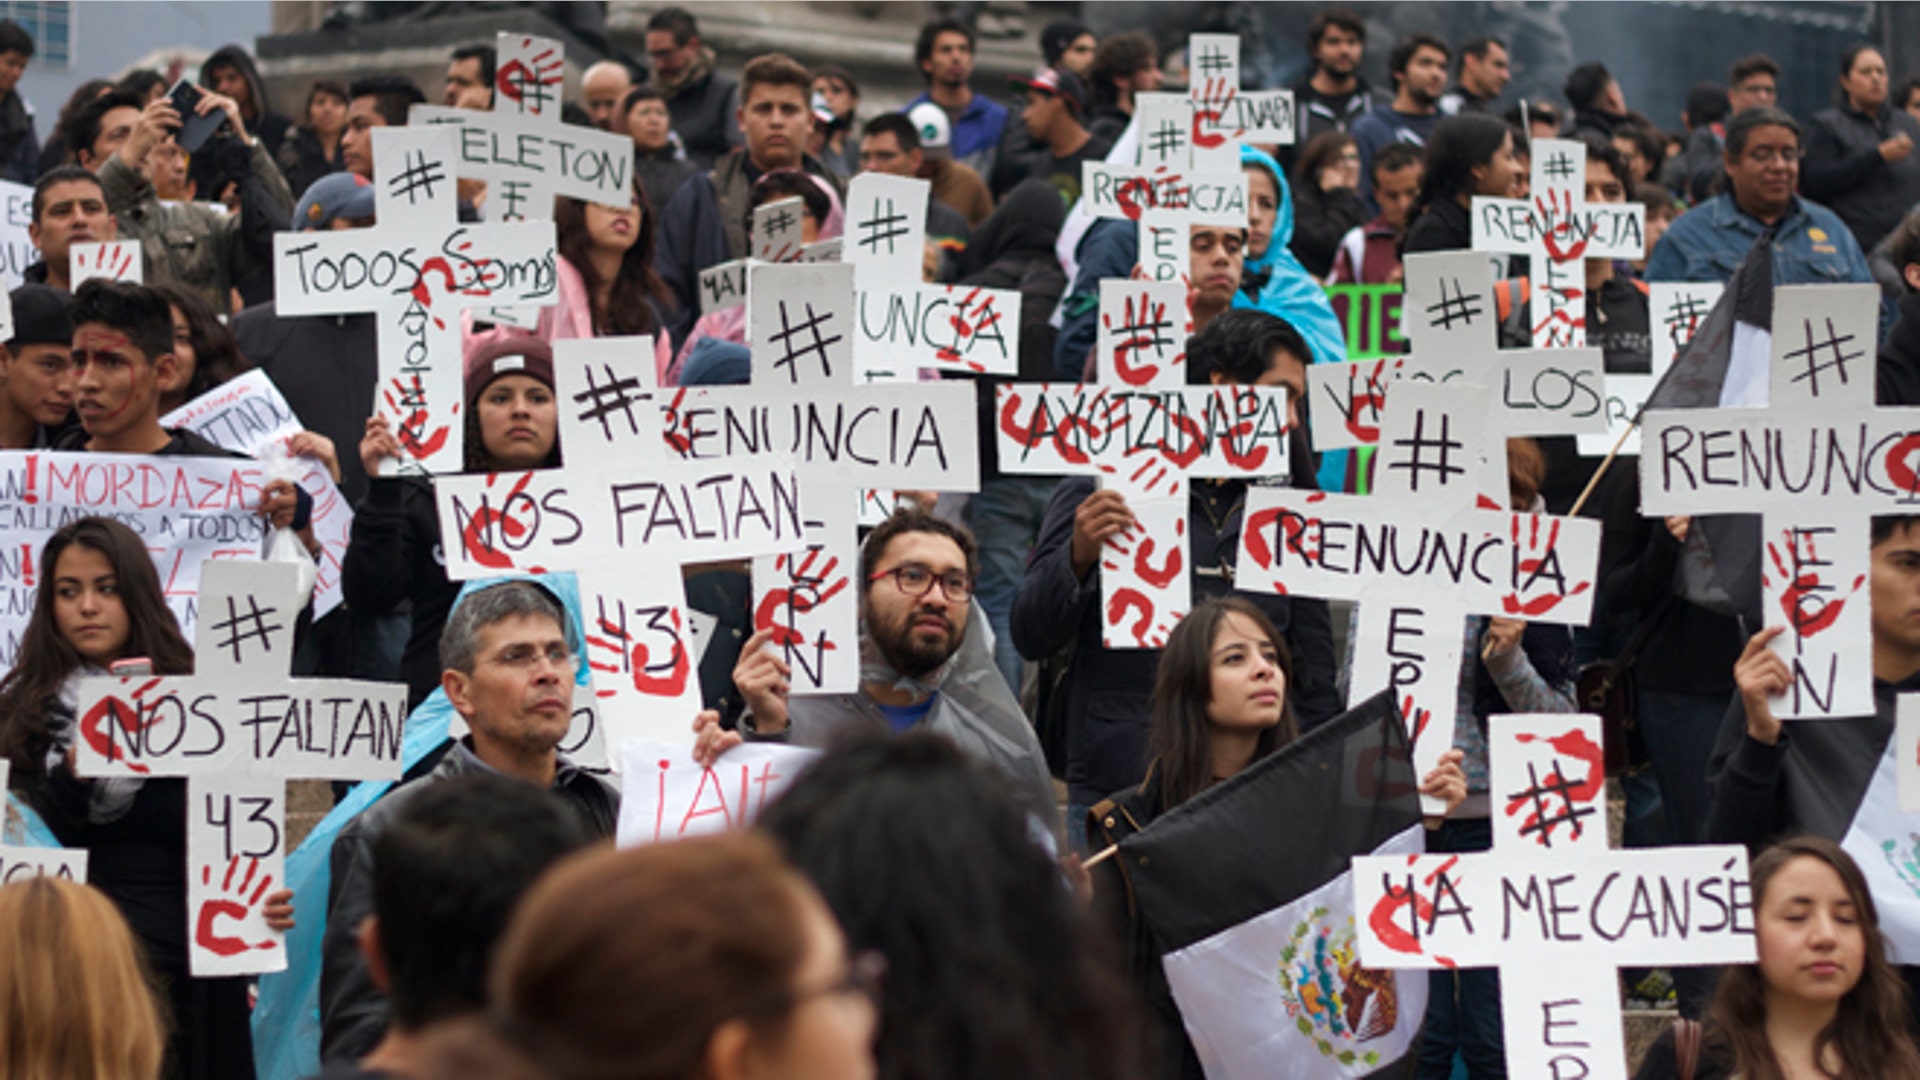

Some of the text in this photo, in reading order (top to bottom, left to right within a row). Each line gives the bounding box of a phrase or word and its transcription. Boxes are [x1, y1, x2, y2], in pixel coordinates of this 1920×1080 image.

[389, 149, 446, 204] #
[859, 197, 910, 255] #
[1426, 277, 1482, 330] #
[768, 300, 842, 383] #
[1783, 317, 1865, 397] #
[1021, 390, 1285, 463] AYOTZINAPA
[1388, 409, 1465, 491] #
[453, 488, 583, 563] NOS
[611, 471, 803, 548] FALTAN
[1276, 510, 1566, 595] RENUNCIA
[212, 595, 284, 662] #
[597, 595, 683, 673] 43
[107, 695, 403, 765] NOS FALTAN
[205, 793, 281, 861] 43
